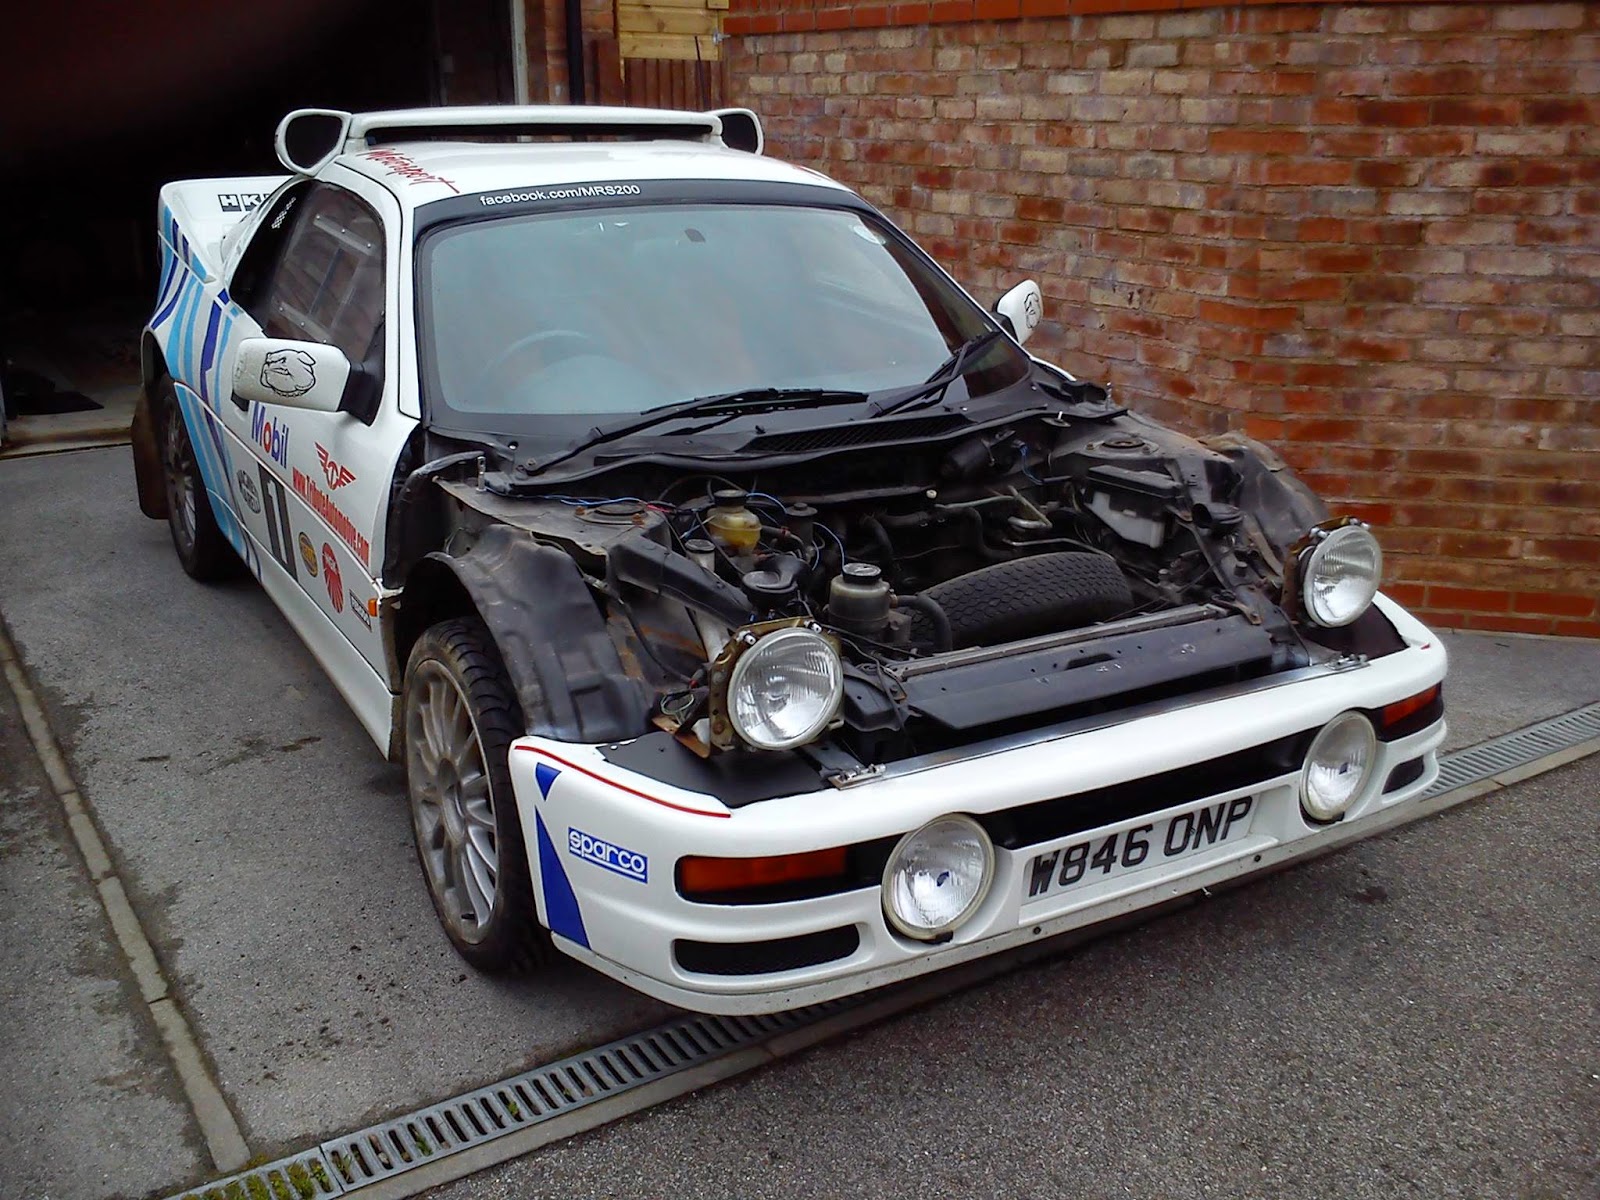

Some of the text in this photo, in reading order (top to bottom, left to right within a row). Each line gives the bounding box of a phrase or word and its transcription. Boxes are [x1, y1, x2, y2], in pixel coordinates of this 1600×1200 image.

[218, 194, 270, 211] HK
[480, 185, 640, 206] facebook.com/MRS200
[251, 401, 289, 470] Mobil
[569, 830, 645, 873] sparco
[1028, 796, 1253, 897] W846 ONP
